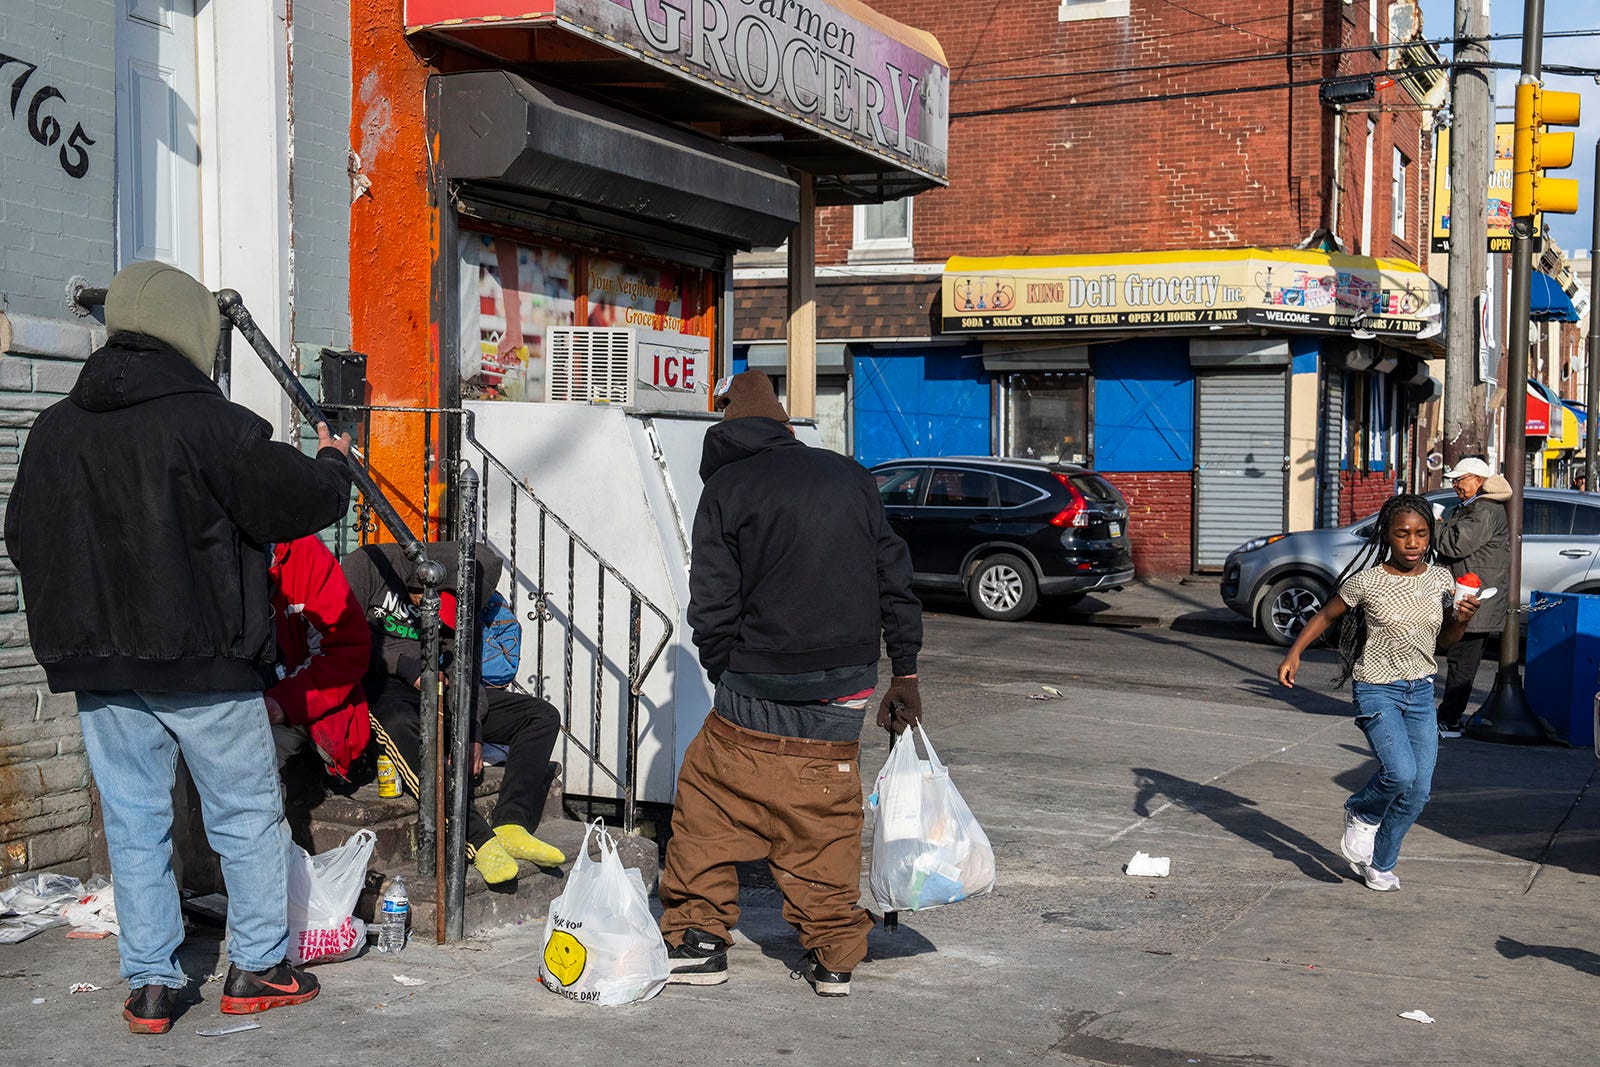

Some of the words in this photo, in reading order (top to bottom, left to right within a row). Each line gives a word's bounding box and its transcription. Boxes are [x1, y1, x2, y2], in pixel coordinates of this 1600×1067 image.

[738, 0, 855, 59] armen
[631, 0, 919, 157] GROCERY
[0, 53, 96, 179] 765
[1490, 238, 1512, 251] OPEN
[591, 271, 613, 292] Your
[1027, 282, 1064, 303] KING
[1068, 274, 1117, 308] Deli
[1124, 273, 1220, 308] Grocery
[1222, 285, 1245, 302] Inc.
[625, 306, 663, 330] Grocery
[663, 313, 685, 332] Store
[961, 317, 983, 328] SODA
[992, 316, 1023, 327] SNACKS
[1031, 315, 1065, 326] CANDIES
[1074, 314, 1089, 325] ICE
[1090, 313, 1119, 324] CREAM
[1128, 312, 1152, 323] OPEN
[1153, 312, 1165, 322] 24
[1166, 311, 1197, 322] HOURS
[1215, 310, 1238, 321] DAYS
[1266, 311, 1311, 323] WELCOME
[1328, 315, 1350, 328] OPEN
[1402, 321, 1421, 332] DAYS
[653, 353, 696, 389] ICE
[580, 991, 601, 1001] DAY!
